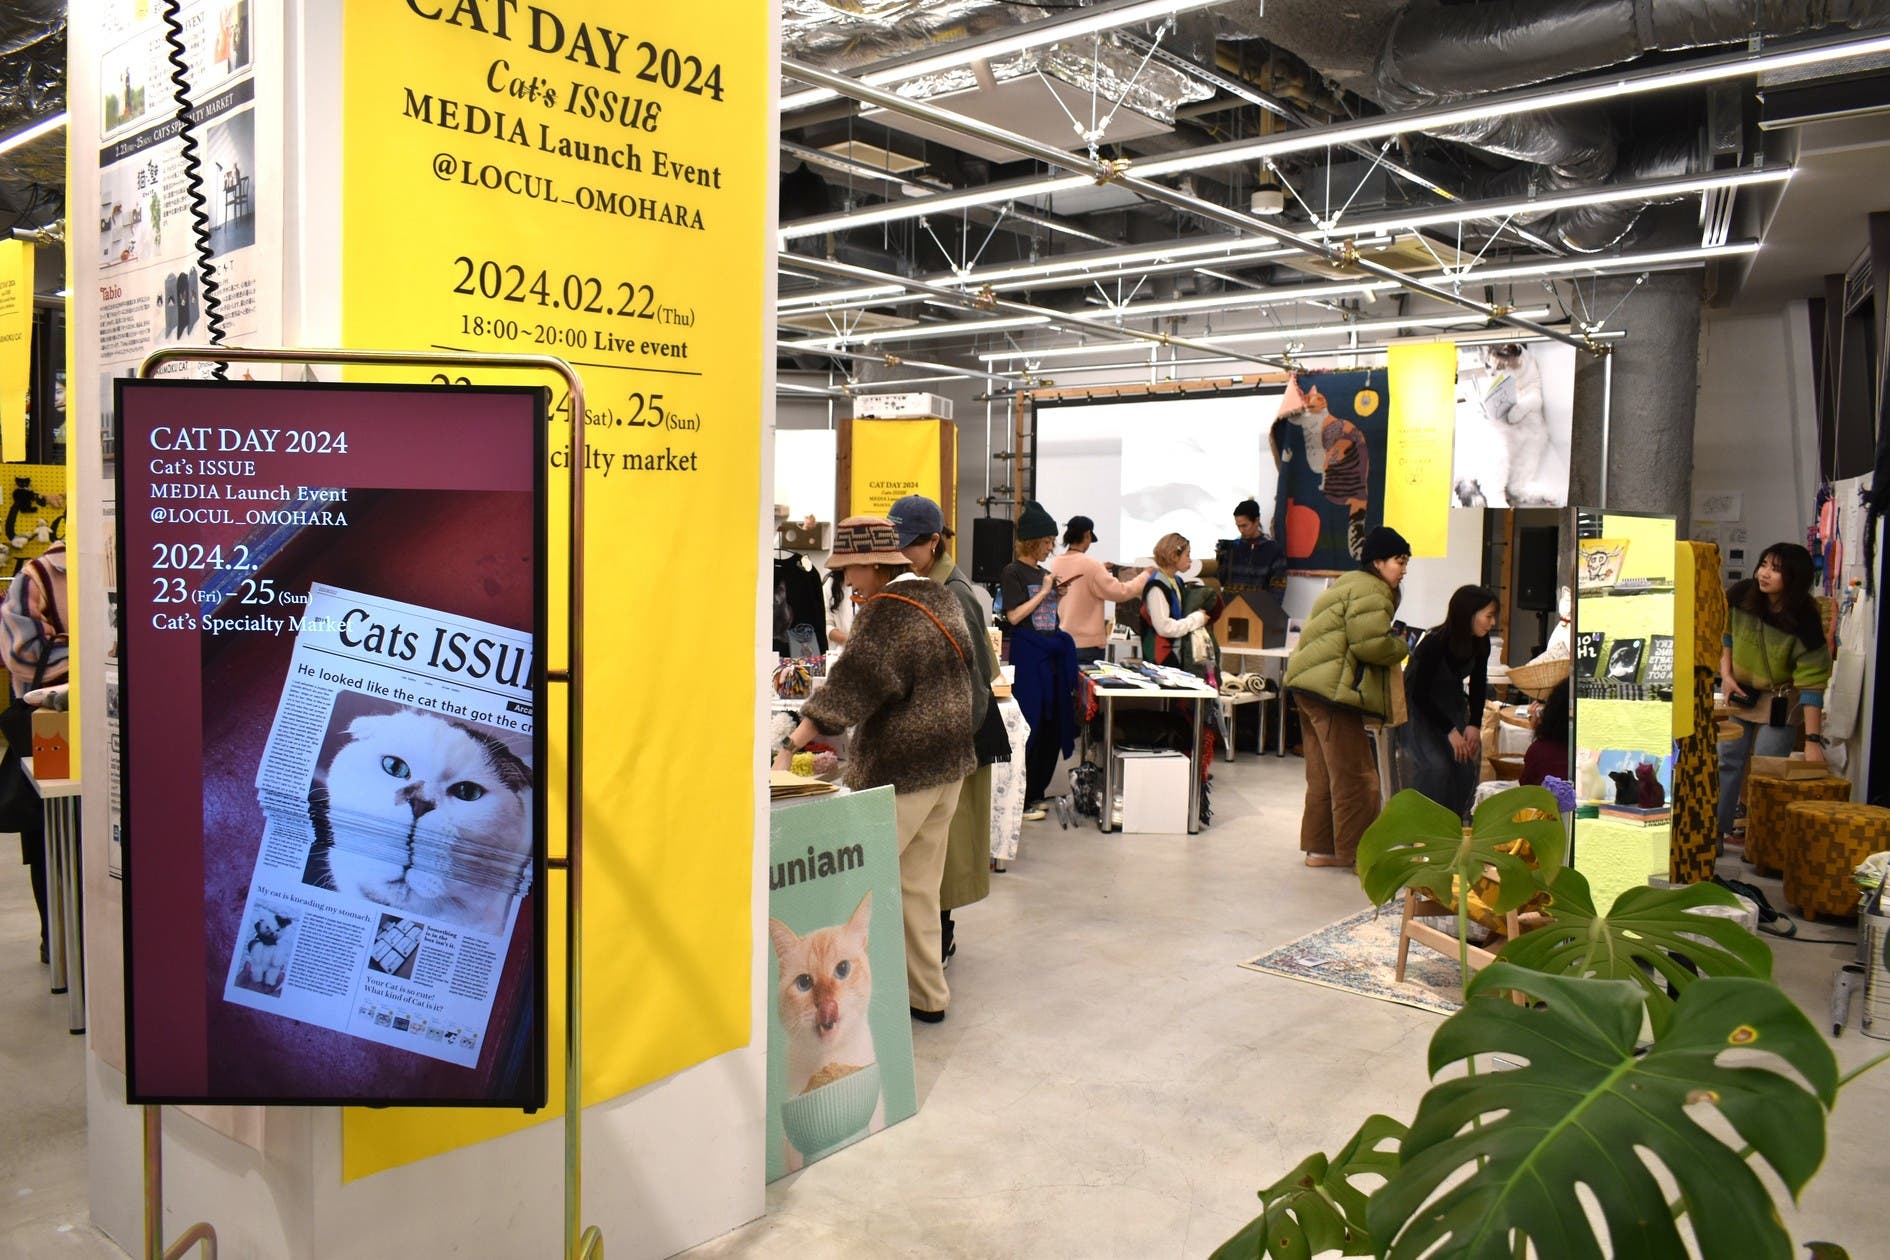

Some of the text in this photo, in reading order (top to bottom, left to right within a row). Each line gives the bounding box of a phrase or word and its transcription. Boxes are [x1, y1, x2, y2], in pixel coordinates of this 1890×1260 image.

[528, 6, 629, 75] DAY
[636, 41, 725, 102] 2024
[205, 93, 234, 115] MARKET
[486, 59, 662, 133] Cat's ISSUE
[403, 88, 722, 190] MEDIA Launch Event
[432, 152, 705, 231] @LOCUL_OMOHARA
[100, 285, 122, 301] Tabio
[594, 331, 635, 354] Live
[640, 338, 688, 359] event
[149, 426, 348, 455] CAT DAY 2024
[150, 459, 256, 476] Cat's ISSUE
[622, 448, 698, 471] market
[150, 484, 348, 503] MEDIA Launch Event
[869, 481, 919, 489] CAT DAY 2024
[150, 508, 349, 528] @LOCUL_OMOHARA
[152, 544, 259, 571] 2024.2.
[152, 614, 353, 637] Cat's Specialty Market
[338, 608, 419, 662] Cats
[298, 663, 315, 676] He
[320, 668, 363, 689] looked
[367, 681, 390, 696] like
[393, 688, 415, 702] the
[418, 695, 437, 709] cat
[441, 700, 468, 716] that
[471, 709, 493, 724] got
[497, 714, 517, 729] the
[769, 842, 865, 890] uniam
[258, 886, 268, 896] My
[270, 890, 281, 898] cat
[290, 894, 324, 911] kneading
[325, 906, 337, 914] my
[364, 984, 384, 996] What
[385, 989, 402, 1001] kind
[403, 995, 411, 1003] of
[412, 998, 425, 1007] Cat
[367, 976, 384, 987] Your
[385, 981, 398, 990] Cat
